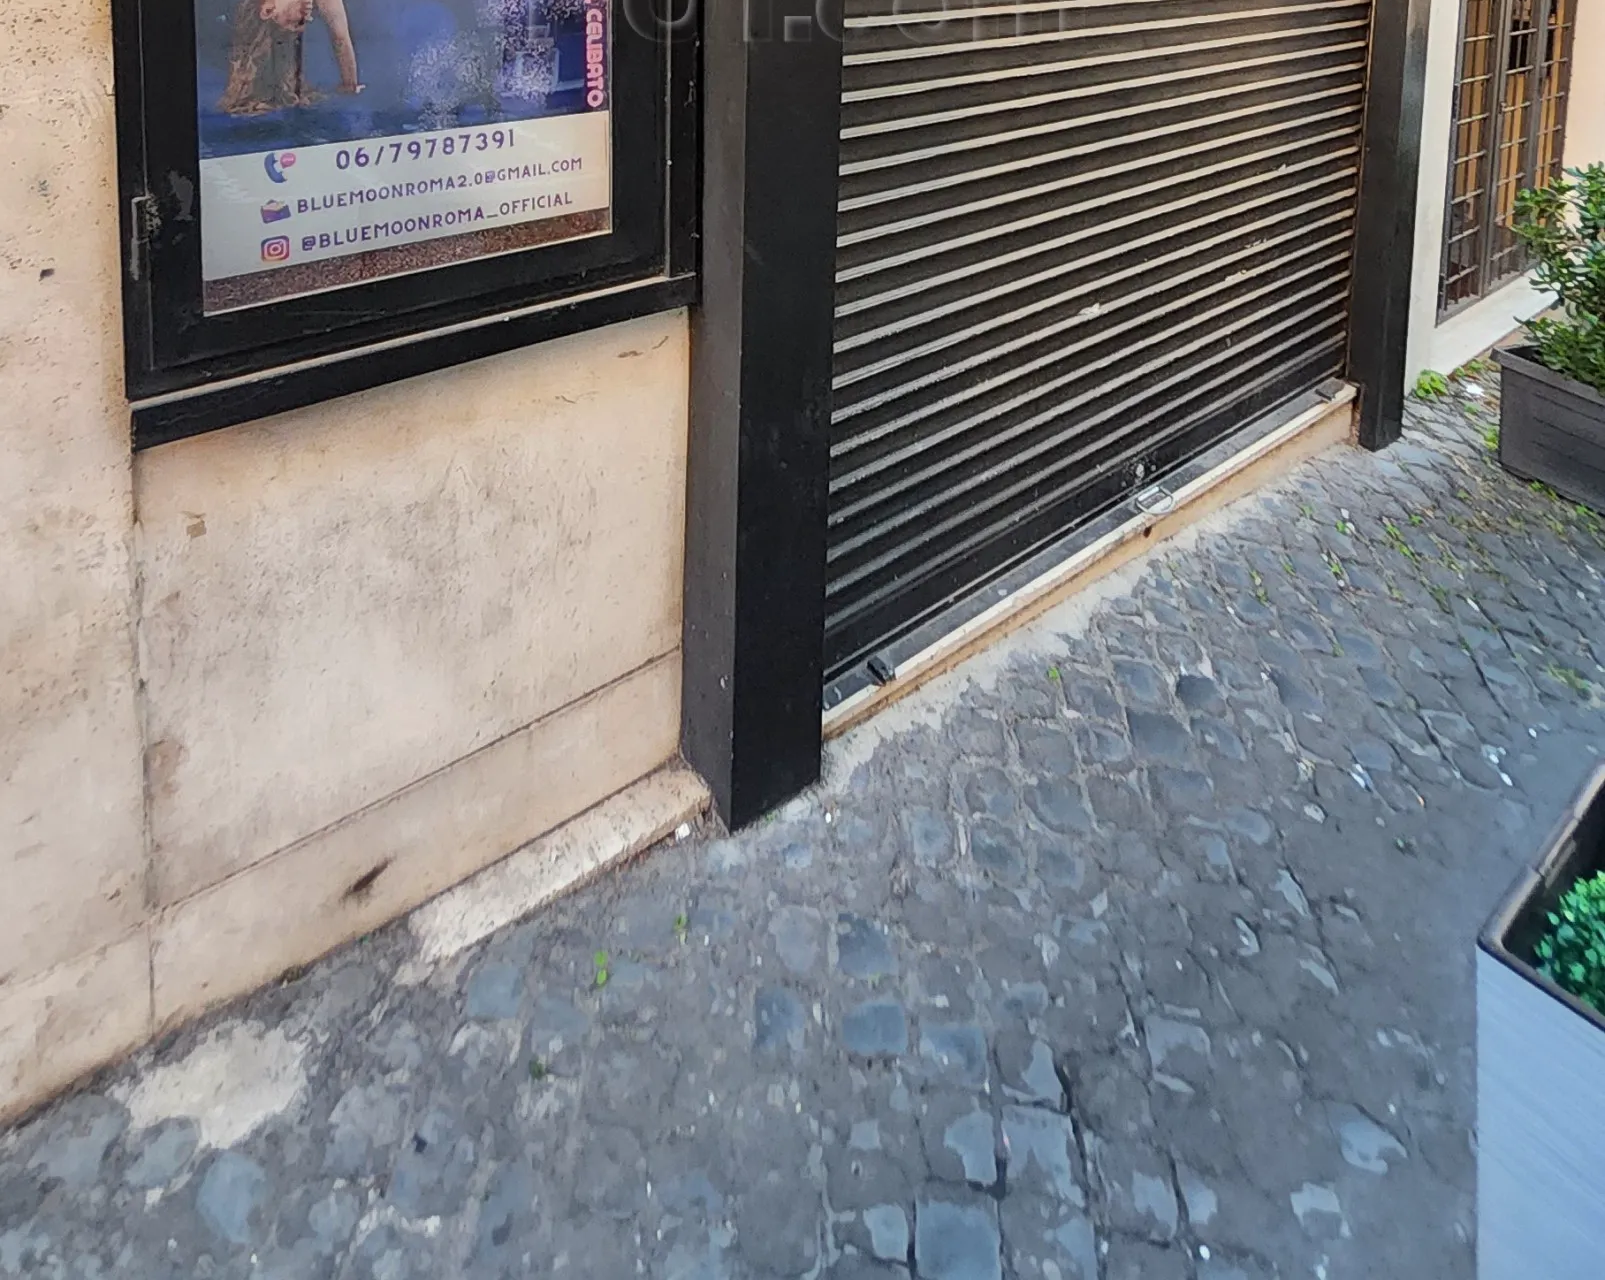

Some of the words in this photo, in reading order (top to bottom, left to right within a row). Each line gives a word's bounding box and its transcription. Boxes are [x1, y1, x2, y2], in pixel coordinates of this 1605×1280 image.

[586, 8, 604, 108] CELIBATO
[336, 128, 515, 170] 06/79787391
[296, 157, 583, 214] BLUEMOONROMA2.0@GMAIL.COM
[301, 191, 573, 252] @BLUEMOONROMA_OFFICIAL
